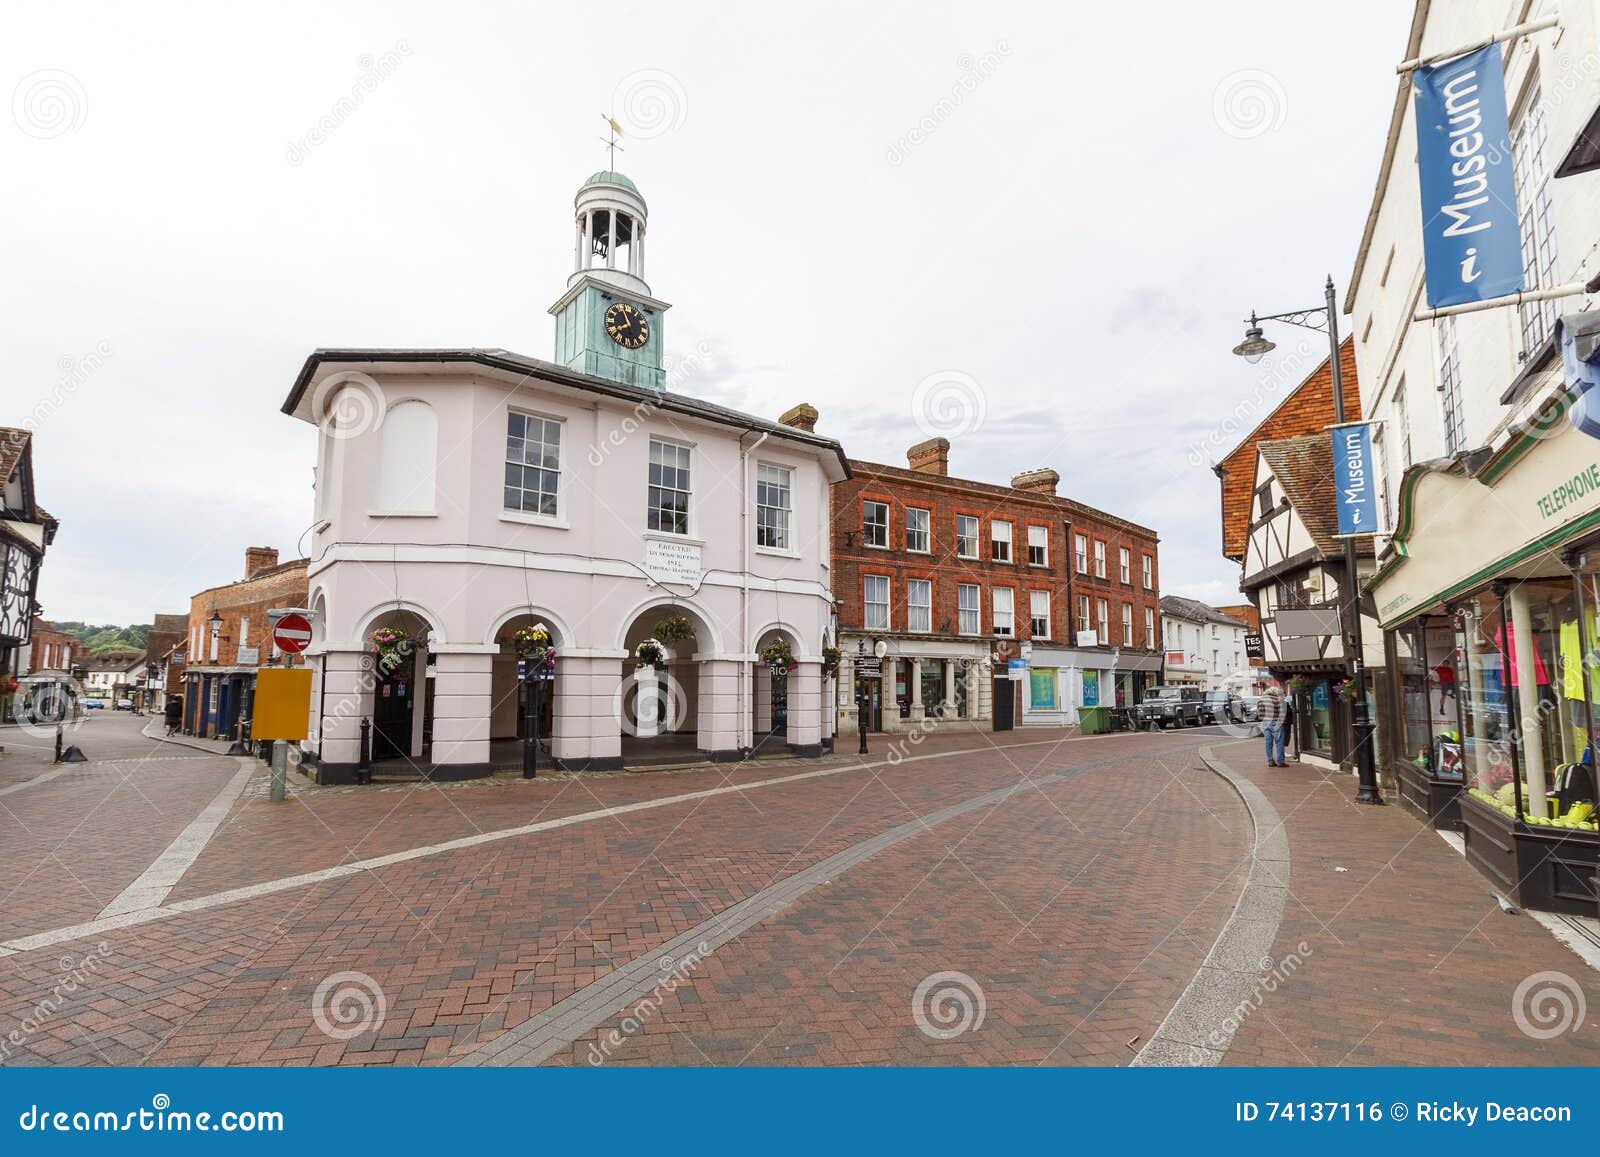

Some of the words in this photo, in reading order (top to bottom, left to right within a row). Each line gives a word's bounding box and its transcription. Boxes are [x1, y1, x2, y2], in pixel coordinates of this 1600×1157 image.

[1441, 70, 1491, 237] Museum
[1344, 433, 1366, 504] Museum
[1536, 463, 1600, 520] TELEPHONE
